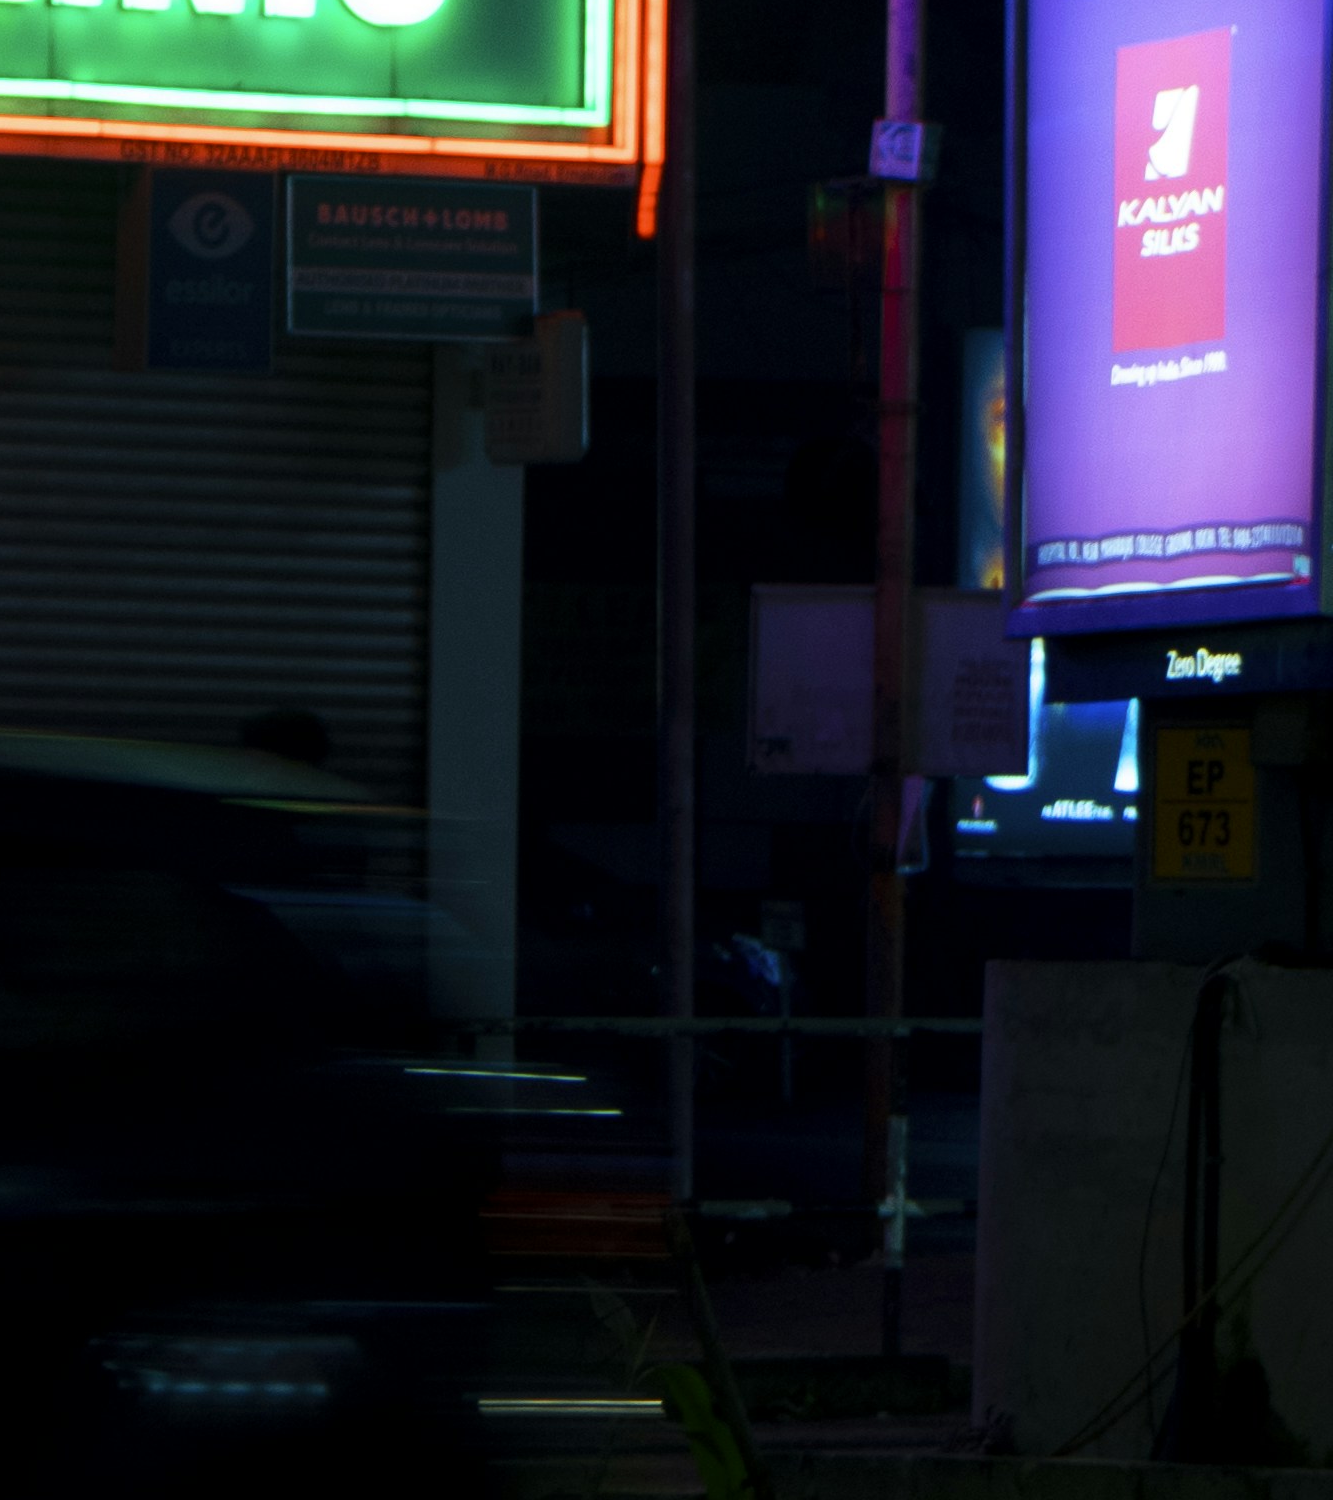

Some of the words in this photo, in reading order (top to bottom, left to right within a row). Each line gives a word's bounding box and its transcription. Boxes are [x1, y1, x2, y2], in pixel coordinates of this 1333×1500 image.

[1117, 186, 1225, 228] KALYAN
[1140, 223, 1201, 258] SILKS
[1188, 760, 1224, 795] EP
[1179, 810, 1230, 846] 673
